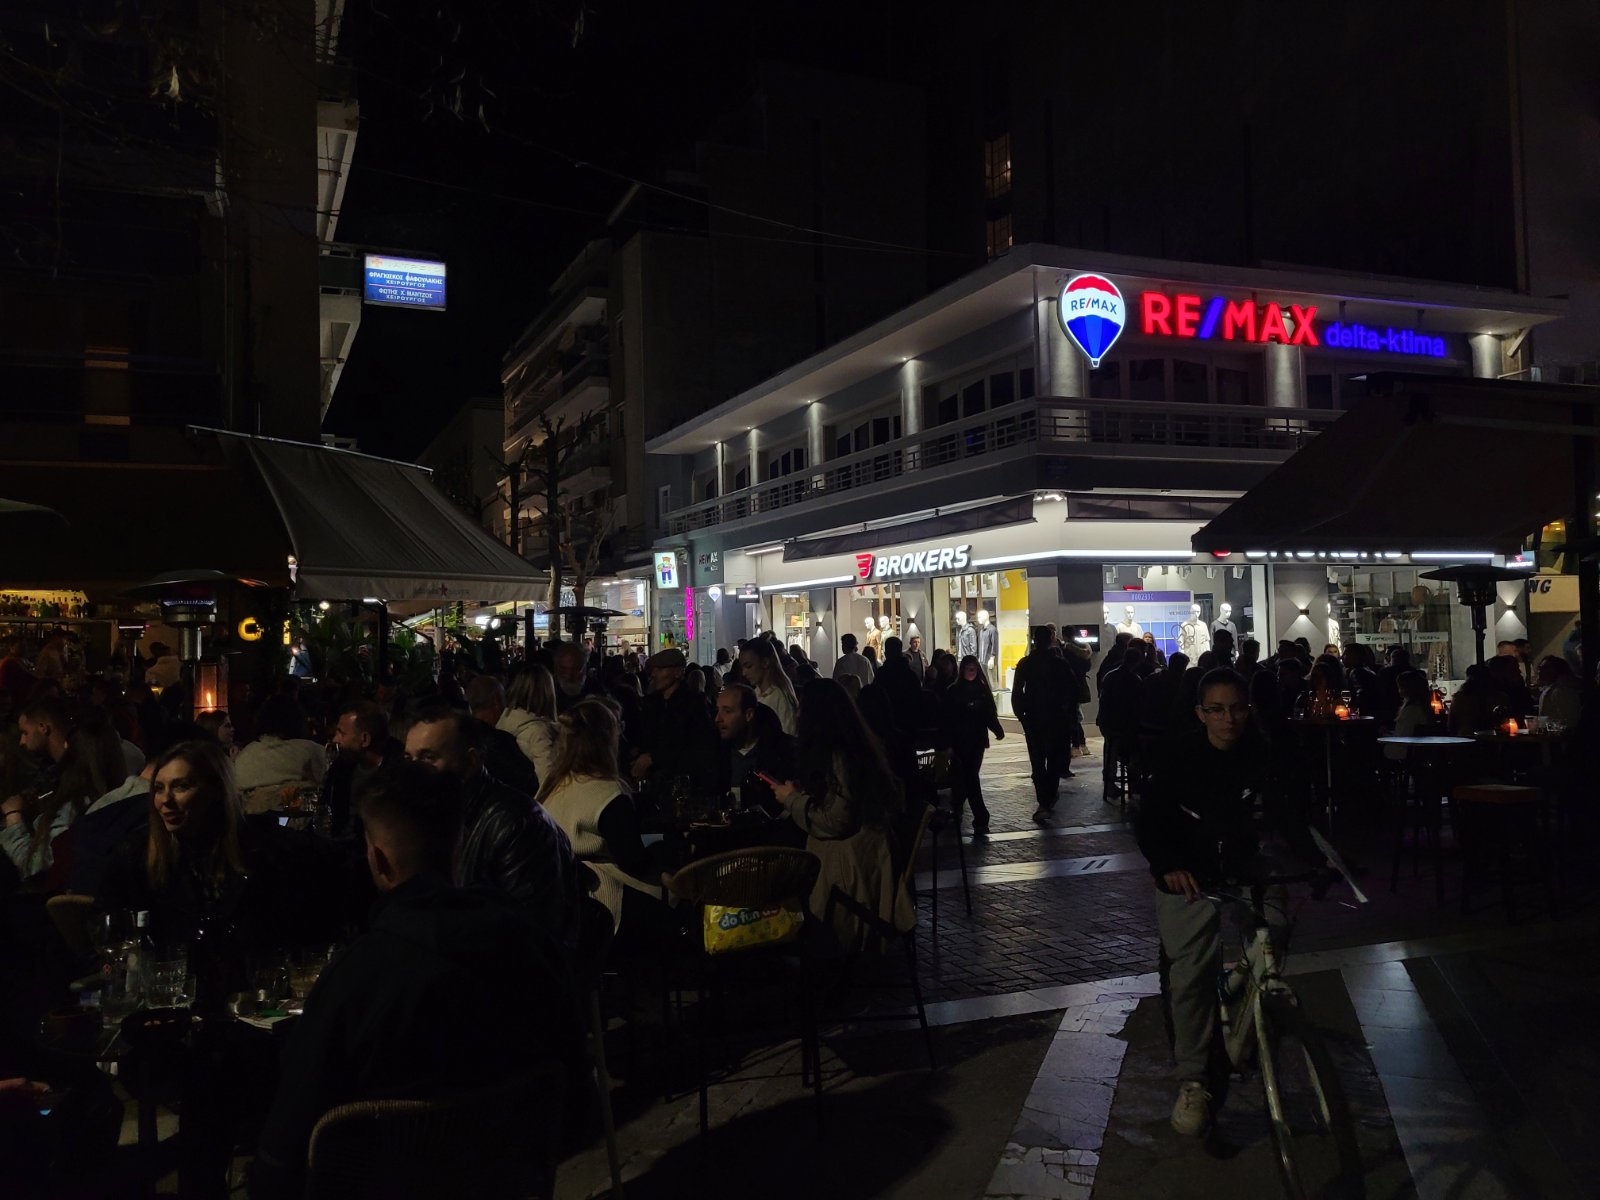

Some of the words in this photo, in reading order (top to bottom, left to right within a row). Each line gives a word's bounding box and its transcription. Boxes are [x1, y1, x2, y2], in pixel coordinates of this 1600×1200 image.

[1071, 298, 1117, 315] RE/MAX
[1141, 291, 1319, 346] RE/MAX
[1325, 321, 1446, 358] delta-ktima
[875, 544, 971, 577] BROKERS
